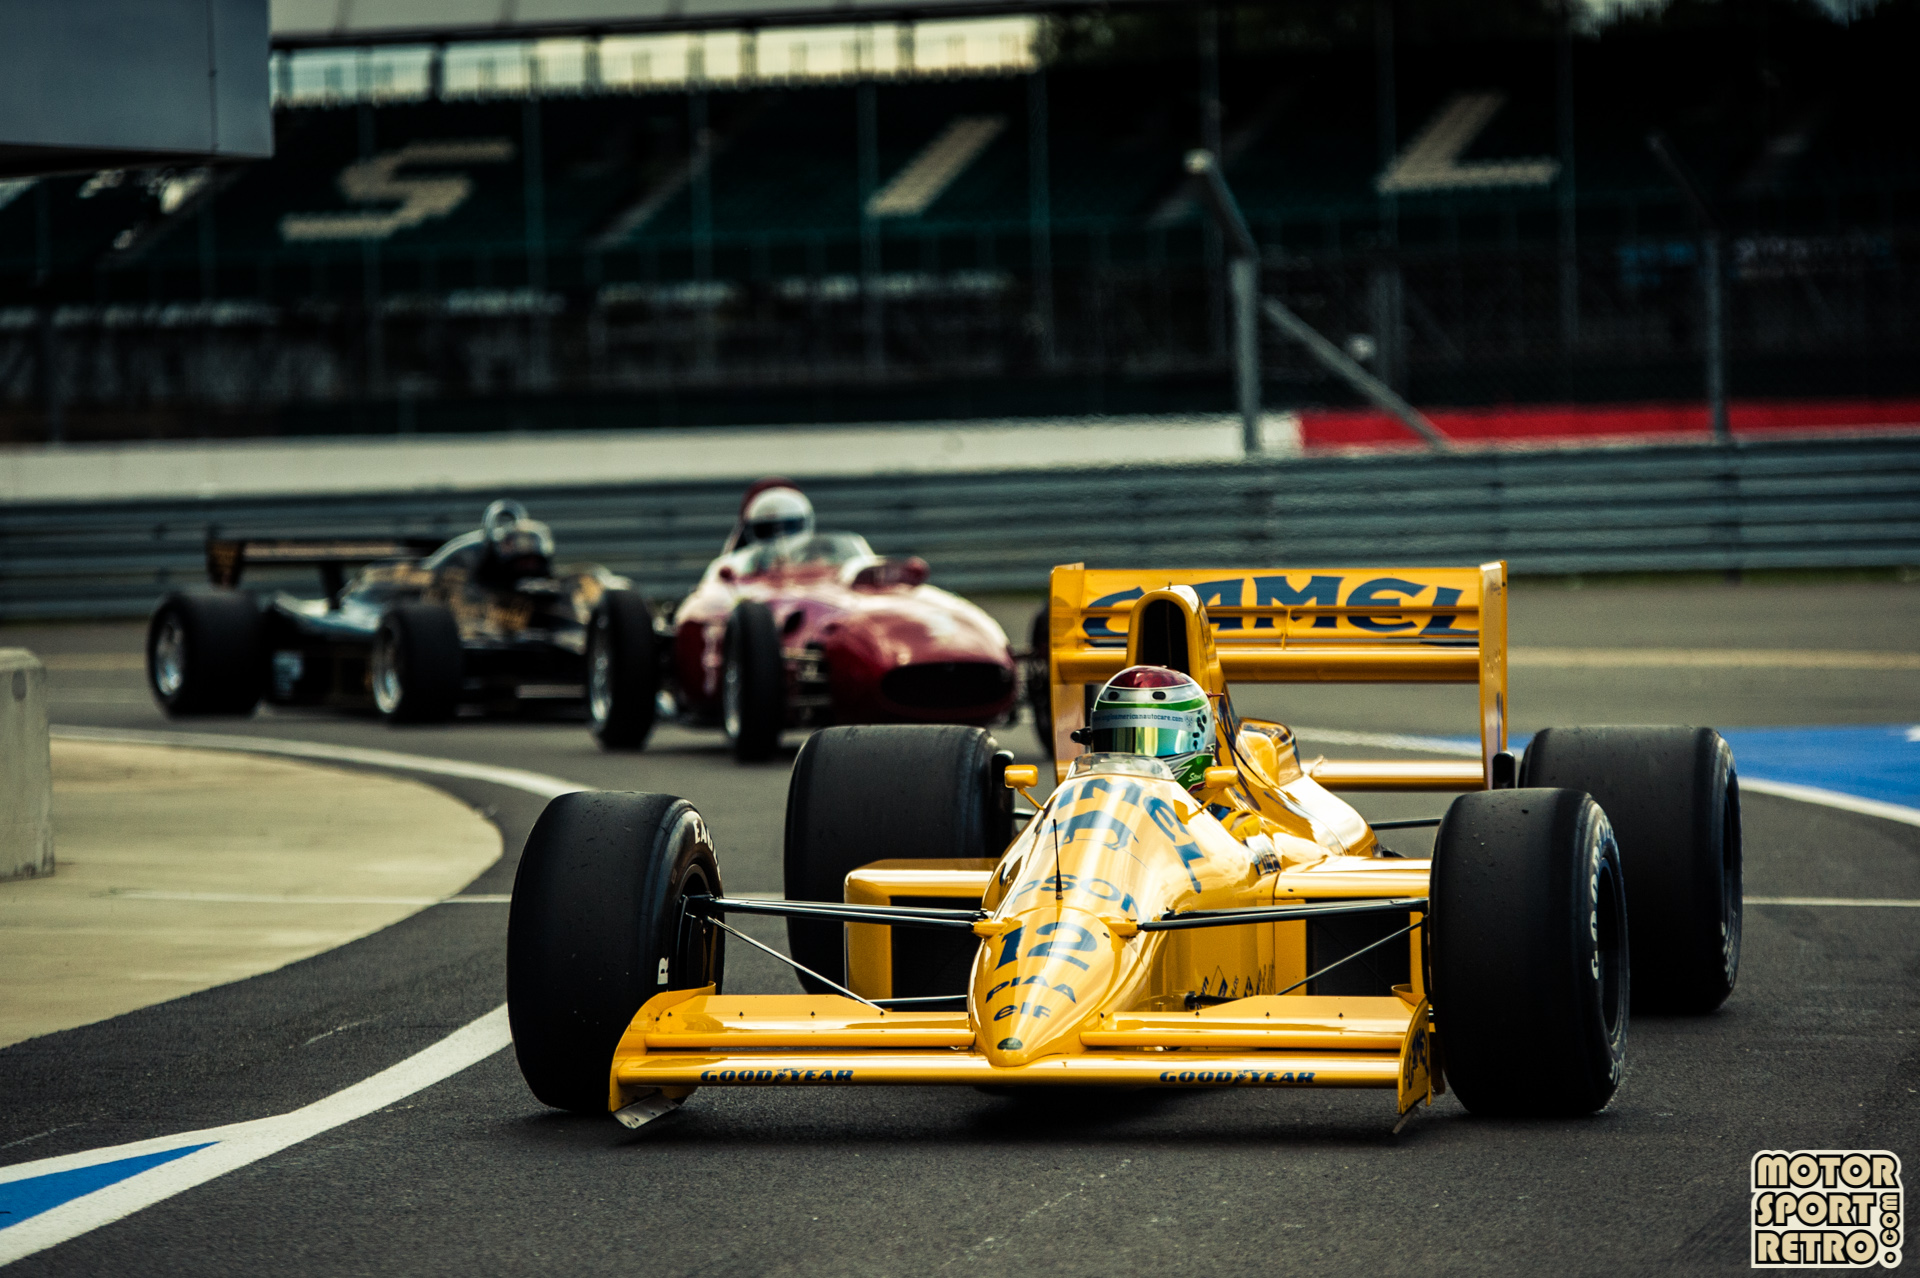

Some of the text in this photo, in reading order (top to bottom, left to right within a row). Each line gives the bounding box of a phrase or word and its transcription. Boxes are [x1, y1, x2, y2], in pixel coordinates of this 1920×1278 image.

[1082, 576, 1479, 637] CAMEL
[994, 922, 1097, 971] 12
[985, 975, 1077, 1004] PIAA
